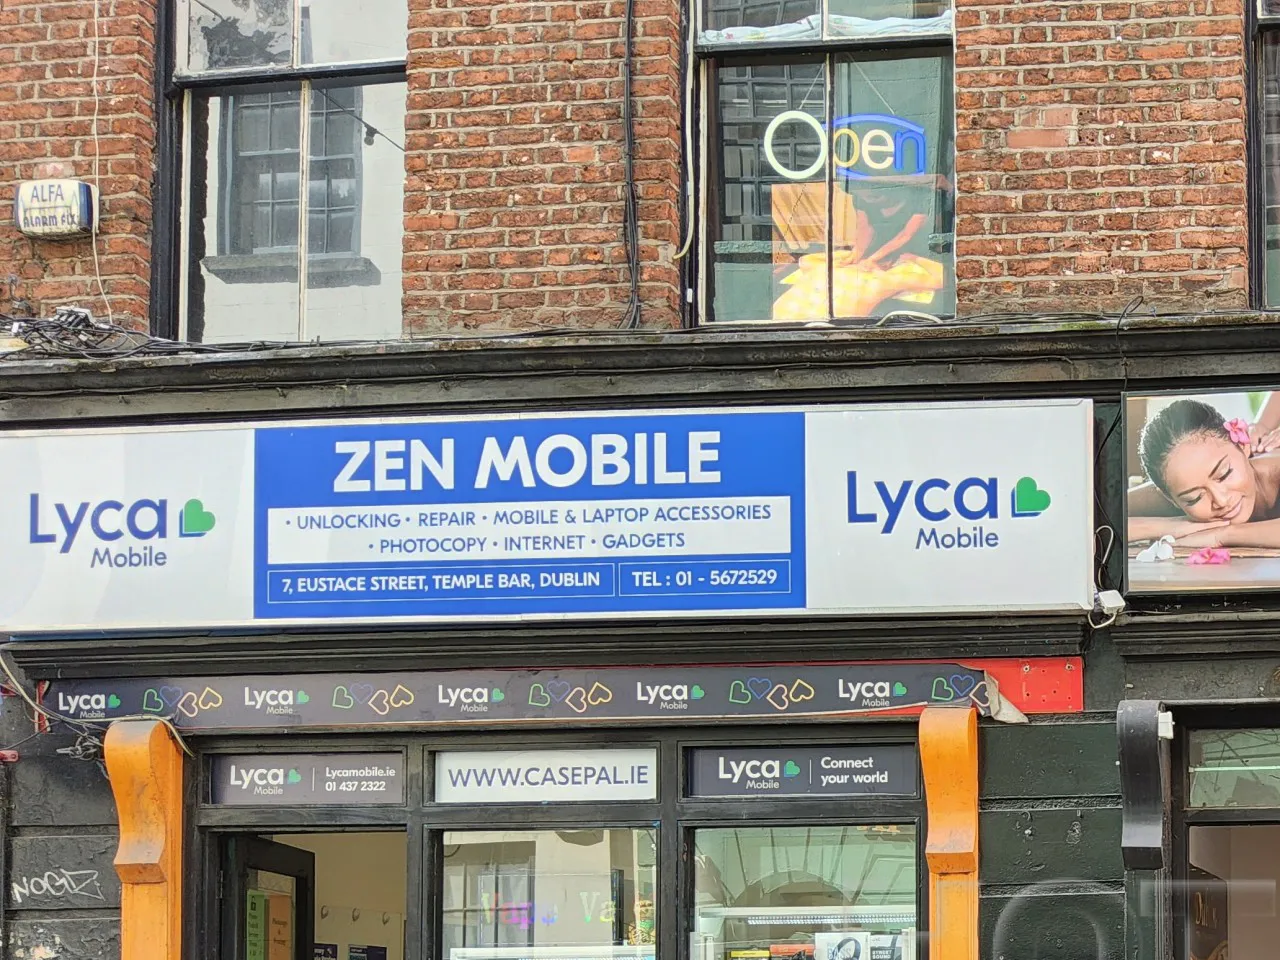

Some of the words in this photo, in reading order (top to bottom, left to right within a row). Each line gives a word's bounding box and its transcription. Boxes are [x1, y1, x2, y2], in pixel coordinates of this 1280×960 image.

[764, 110, 926, 180] Open
[31, 184, 64, 202] ALFA
[333, 438, 455, 492] ZEN
[473, 430, 722, 489] MOBILE
[847, 471, 999, 534] Lyca
[29, 493, 167, 554] Lyca
[297, 512, 401, 530] UNLOCKING
[418, 511, 476, 528] REPAIR
[493, 509, 559, 526] MOBILE
[564, 509, 577, 525] &
[583, 507, 648, 524] LAPTOP
[655, 504, 772, 522] ACCESSORIES
[380, 536, 487, 554] PHOTOCOPY
[504, 535, 585, 551] INTERNET
[602, 532, 685, 550] GADGETS
[915, 527, 999, 549] Mobile
[90, 547, 167, 568] Mobile
[298, 575, 366, 592] EUSTACE
[371, 574, 429, 593] STREET,
[432, 573, 493, 590] TEMPLE
[498, 572, 535, 591] BAR,
[540, 571, 600, 588] DUBLIN
[675, 570, 692, 587] 01
[710, 569, 777, 586] 5672529
[244, 686, 294, 709] Lyca
[438, 684, 488, 708] Lyca
[636, 681, 688, 706] Lyca
[838, 678, 890, 702] Lyca
[58, 692, 106, 714] Lyca
[266, 706, 294, 715] Mobile
[460, 702, 488, 713] Mobile
[659, 701, 688, 711] Mobile
[861, 698, 890, 708] Mobile
[79, 711, 106, 719] Mobile
[325, 766, 396, 780] Lycamobile.ie
[718, 756, 780, 784] Lyca
[821, 756, 873, 770] Connect
[230, 765, 284, 789] Lyca
[325, 781, 337, 792] 01
[339, 780, 359, 792] 437
[361, 780, 386, 791] 2322
[448, 765, 649, 788] WWW.CASEPAL.IE
[746, 779, 780, 790] Mobile
[821, 773, 849, 785] your
[852, 770, 888, 784] world
[254, 786, 284, 795] Mobile
